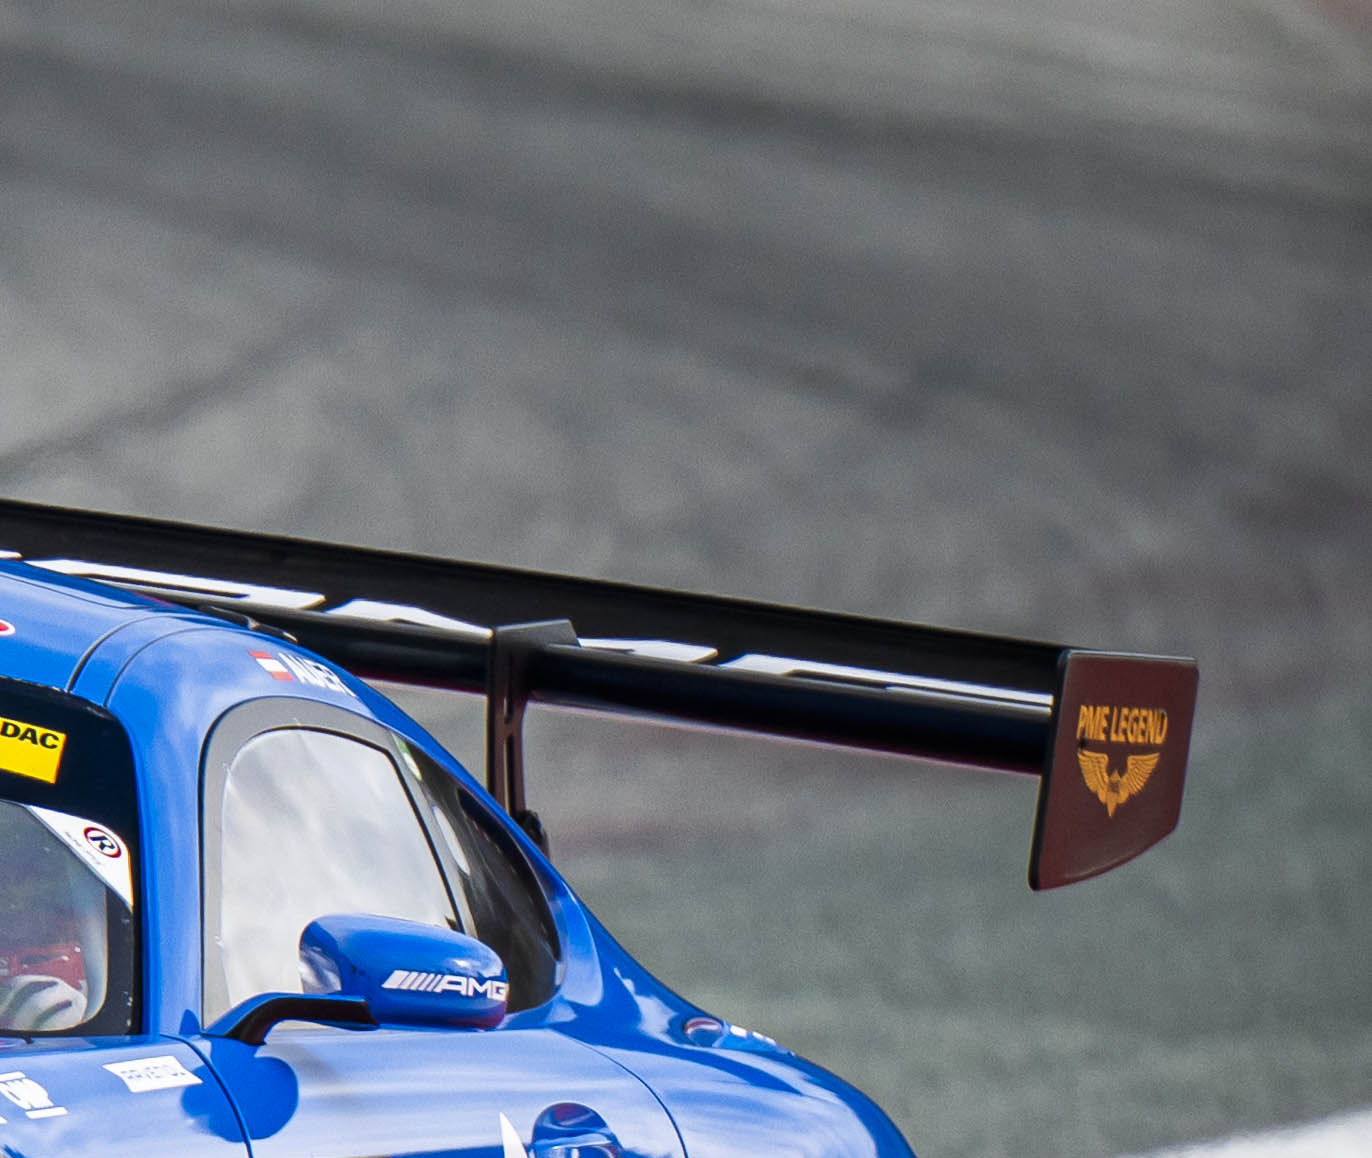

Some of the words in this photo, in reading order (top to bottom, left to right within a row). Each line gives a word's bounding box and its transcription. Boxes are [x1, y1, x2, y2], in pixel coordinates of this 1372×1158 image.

[1076, 705, 1110, 741] PME
[1110, 706, 1168, 744] LEGEND
[433, 974, 510, 1002] AMG
